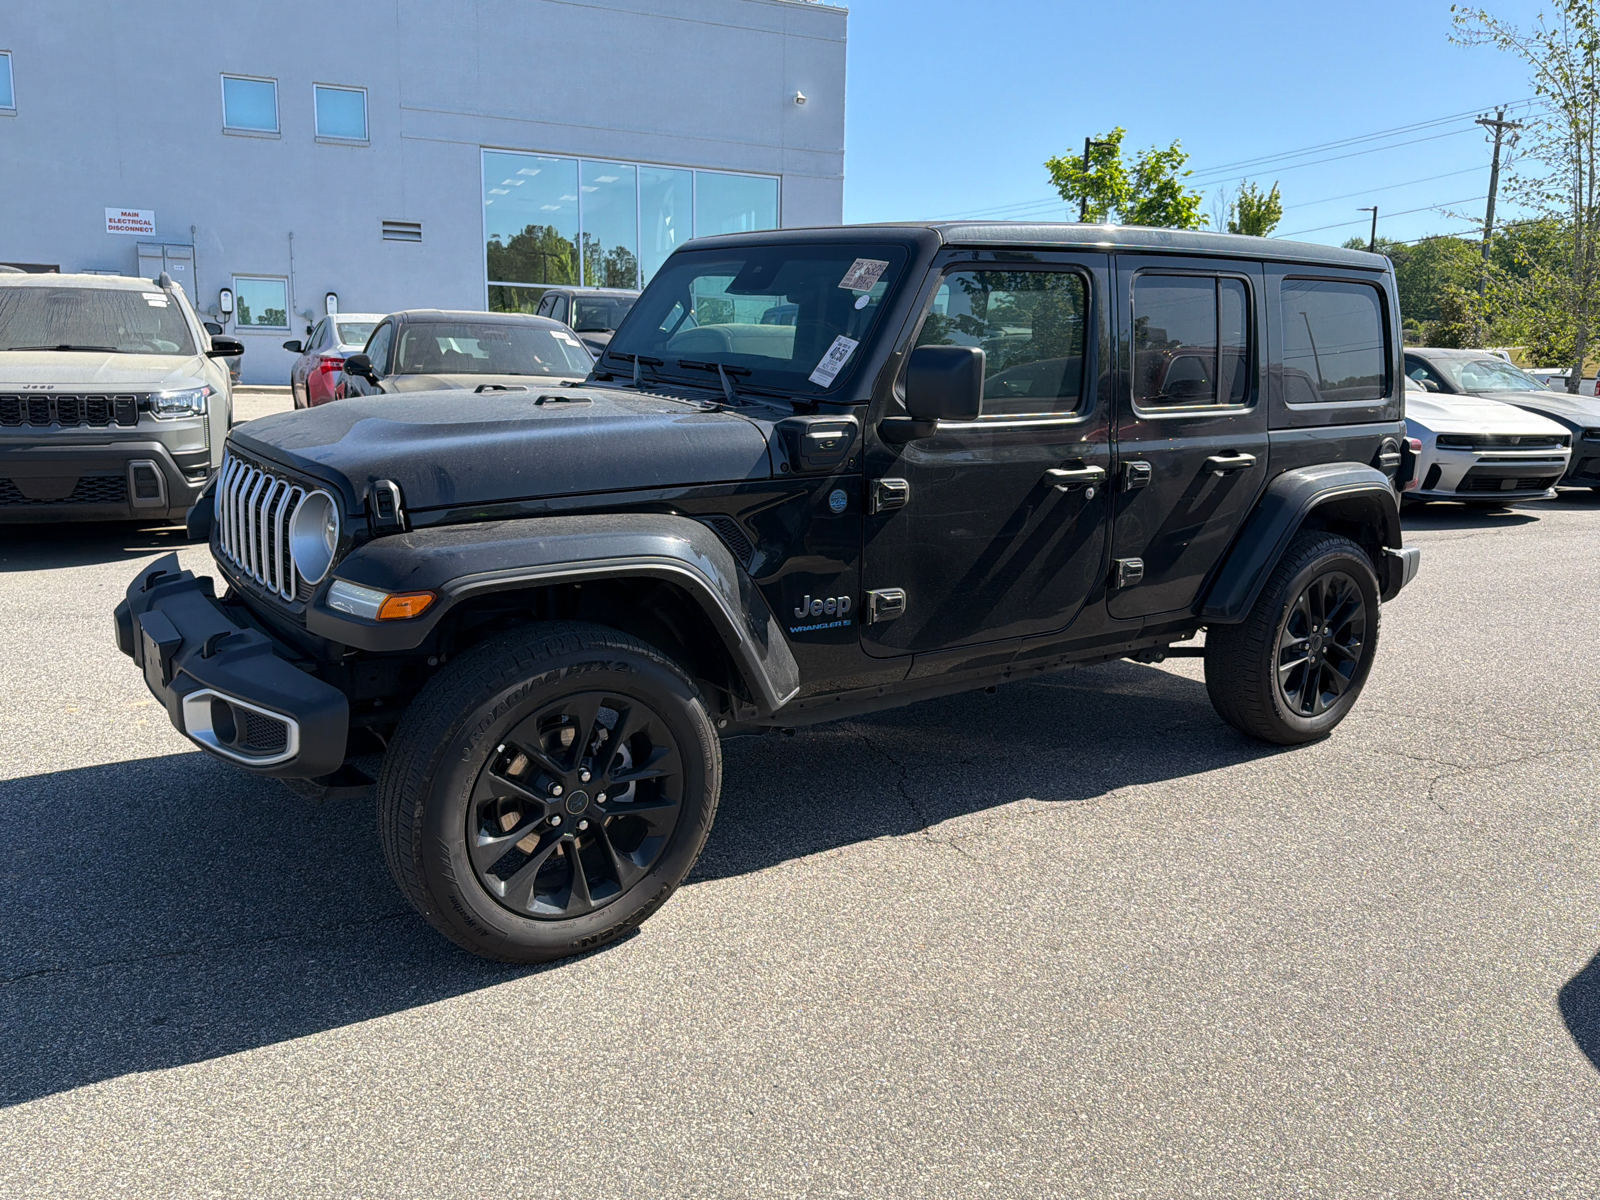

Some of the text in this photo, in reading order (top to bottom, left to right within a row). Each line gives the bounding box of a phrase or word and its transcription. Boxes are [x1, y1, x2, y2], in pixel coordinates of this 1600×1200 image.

[108, 225, 153, 233] DISCONNECT
[794, 595, 851, 619] Jeep
[789, 621, 842, 633] WRANGLER
[581, 889, 661, 948] NEXEN
